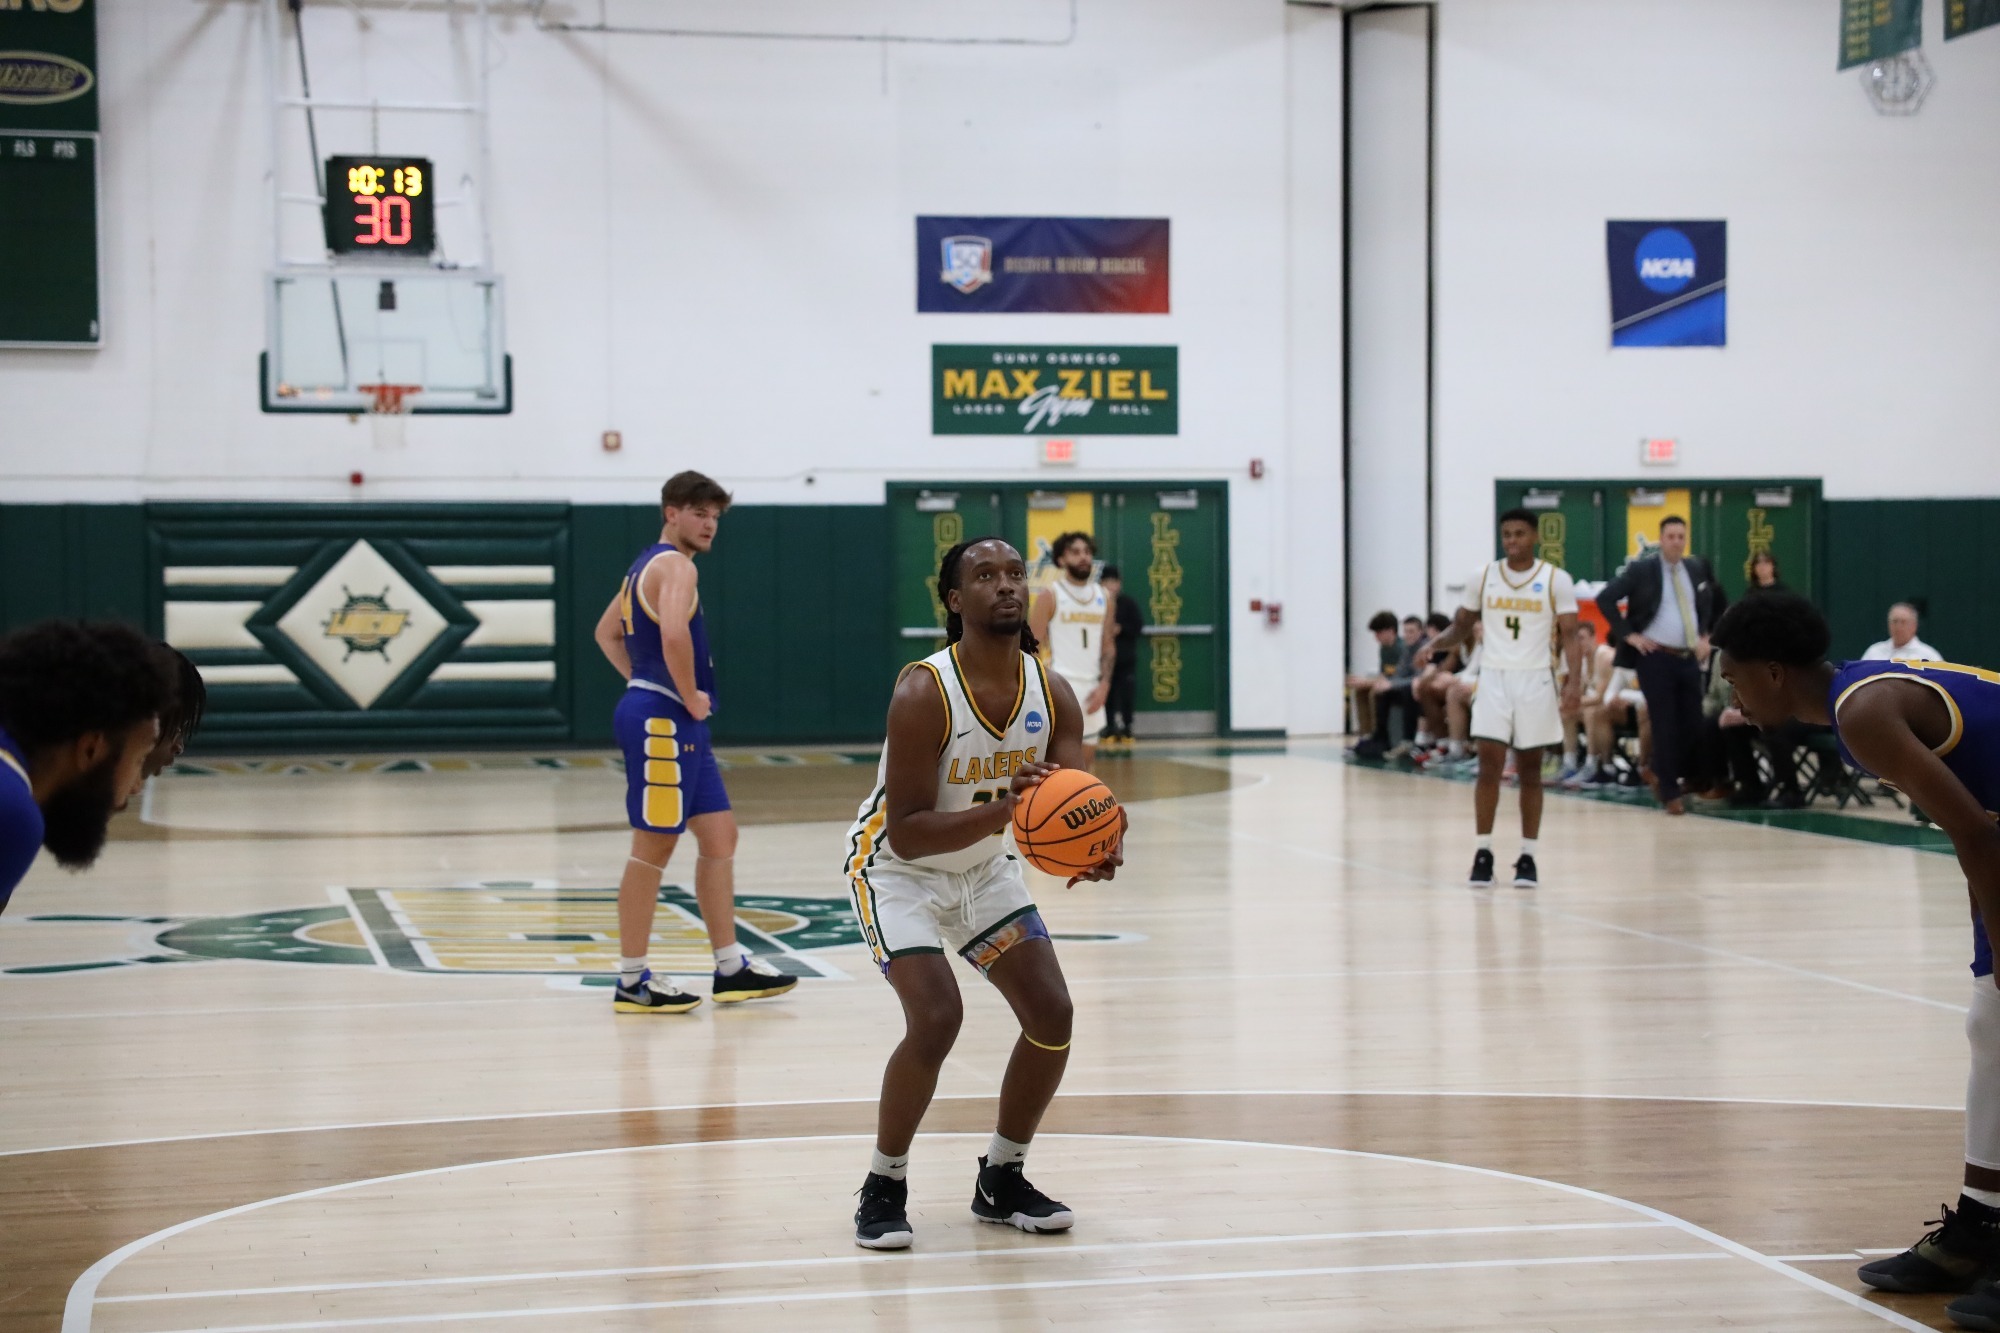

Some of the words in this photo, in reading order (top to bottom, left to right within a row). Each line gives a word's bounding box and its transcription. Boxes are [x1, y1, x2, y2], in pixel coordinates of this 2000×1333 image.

[348, 165, 423, 197] 10:13
[353, 195, 412, 245] 30
[1640, 258, 1695, 278] NCAA
[993, 352, 1040, 364] SUNY
[1046, 352, 1120, 365] OSWEGO
[943, 369, 1041, 400] MAX
[1057, 370, 1169, 400] ZIEL
[1148, 511, 1183, 703] LAKERS
[1487, 596, 1543, 612] LAKERS
[1081, 627, 1088, 649] 1
[1504, 615, 1520, 640] 4
[947, 746, 1038, 785] LAKERS
[1061, 794, 1117, 830] Wilson
